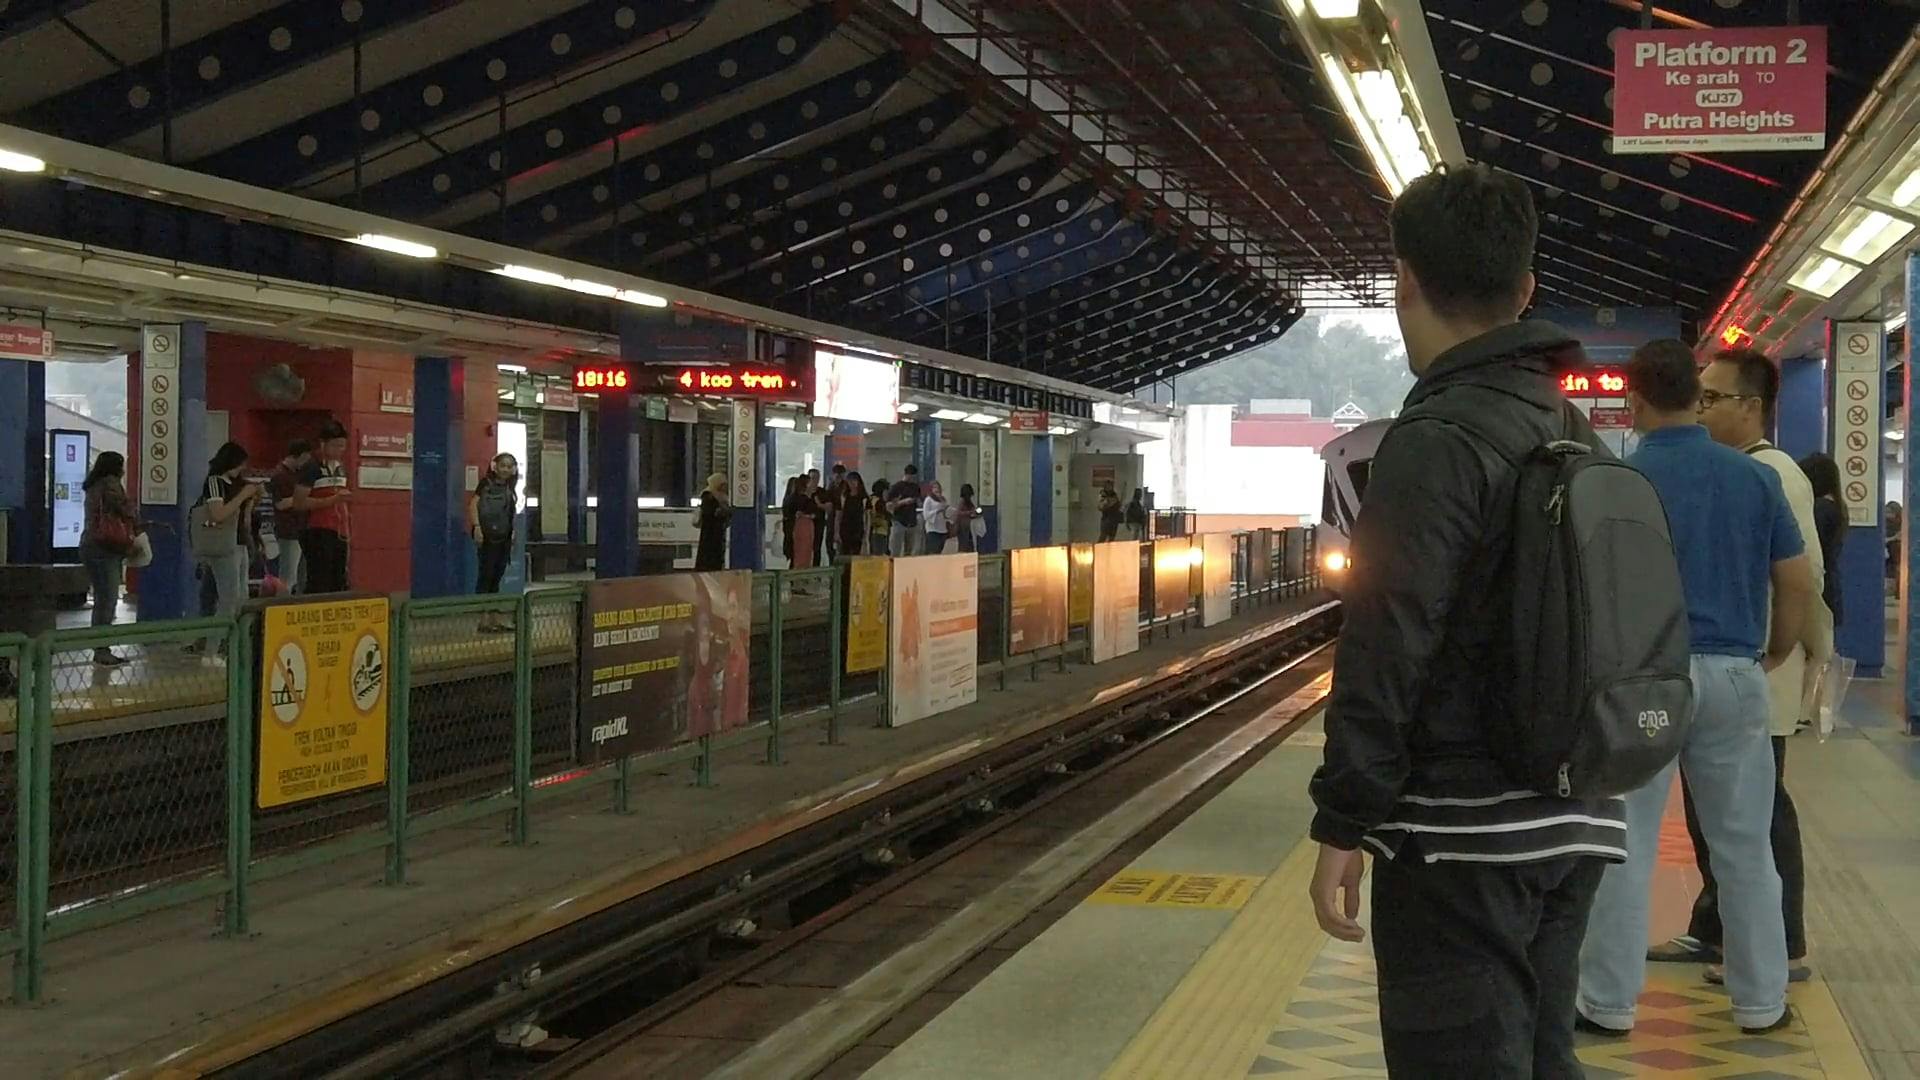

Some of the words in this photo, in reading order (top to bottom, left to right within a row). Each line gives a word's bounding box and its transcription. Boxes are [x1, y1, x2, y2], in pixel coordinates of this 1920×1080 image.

[1635, 41, 1776, 67] Platform
[1786, 39, 1808, 64] 2
[1665, 72, 1691, 85] Ke
[1697, 70, 1740, 85] arah
[1756, 72, 1775, 83] TO
[1701, 92, 1737, 104] KJ37
[1644, 112, 1703, 130] Putra
[1709, 110, 1795, 131] Heights
[680, 371, 693, 387] 4
[1561, 374, 1589, 391] in
[1598, 373, 1624, 391] to
[591, 716, 629, 745] rapidKL
